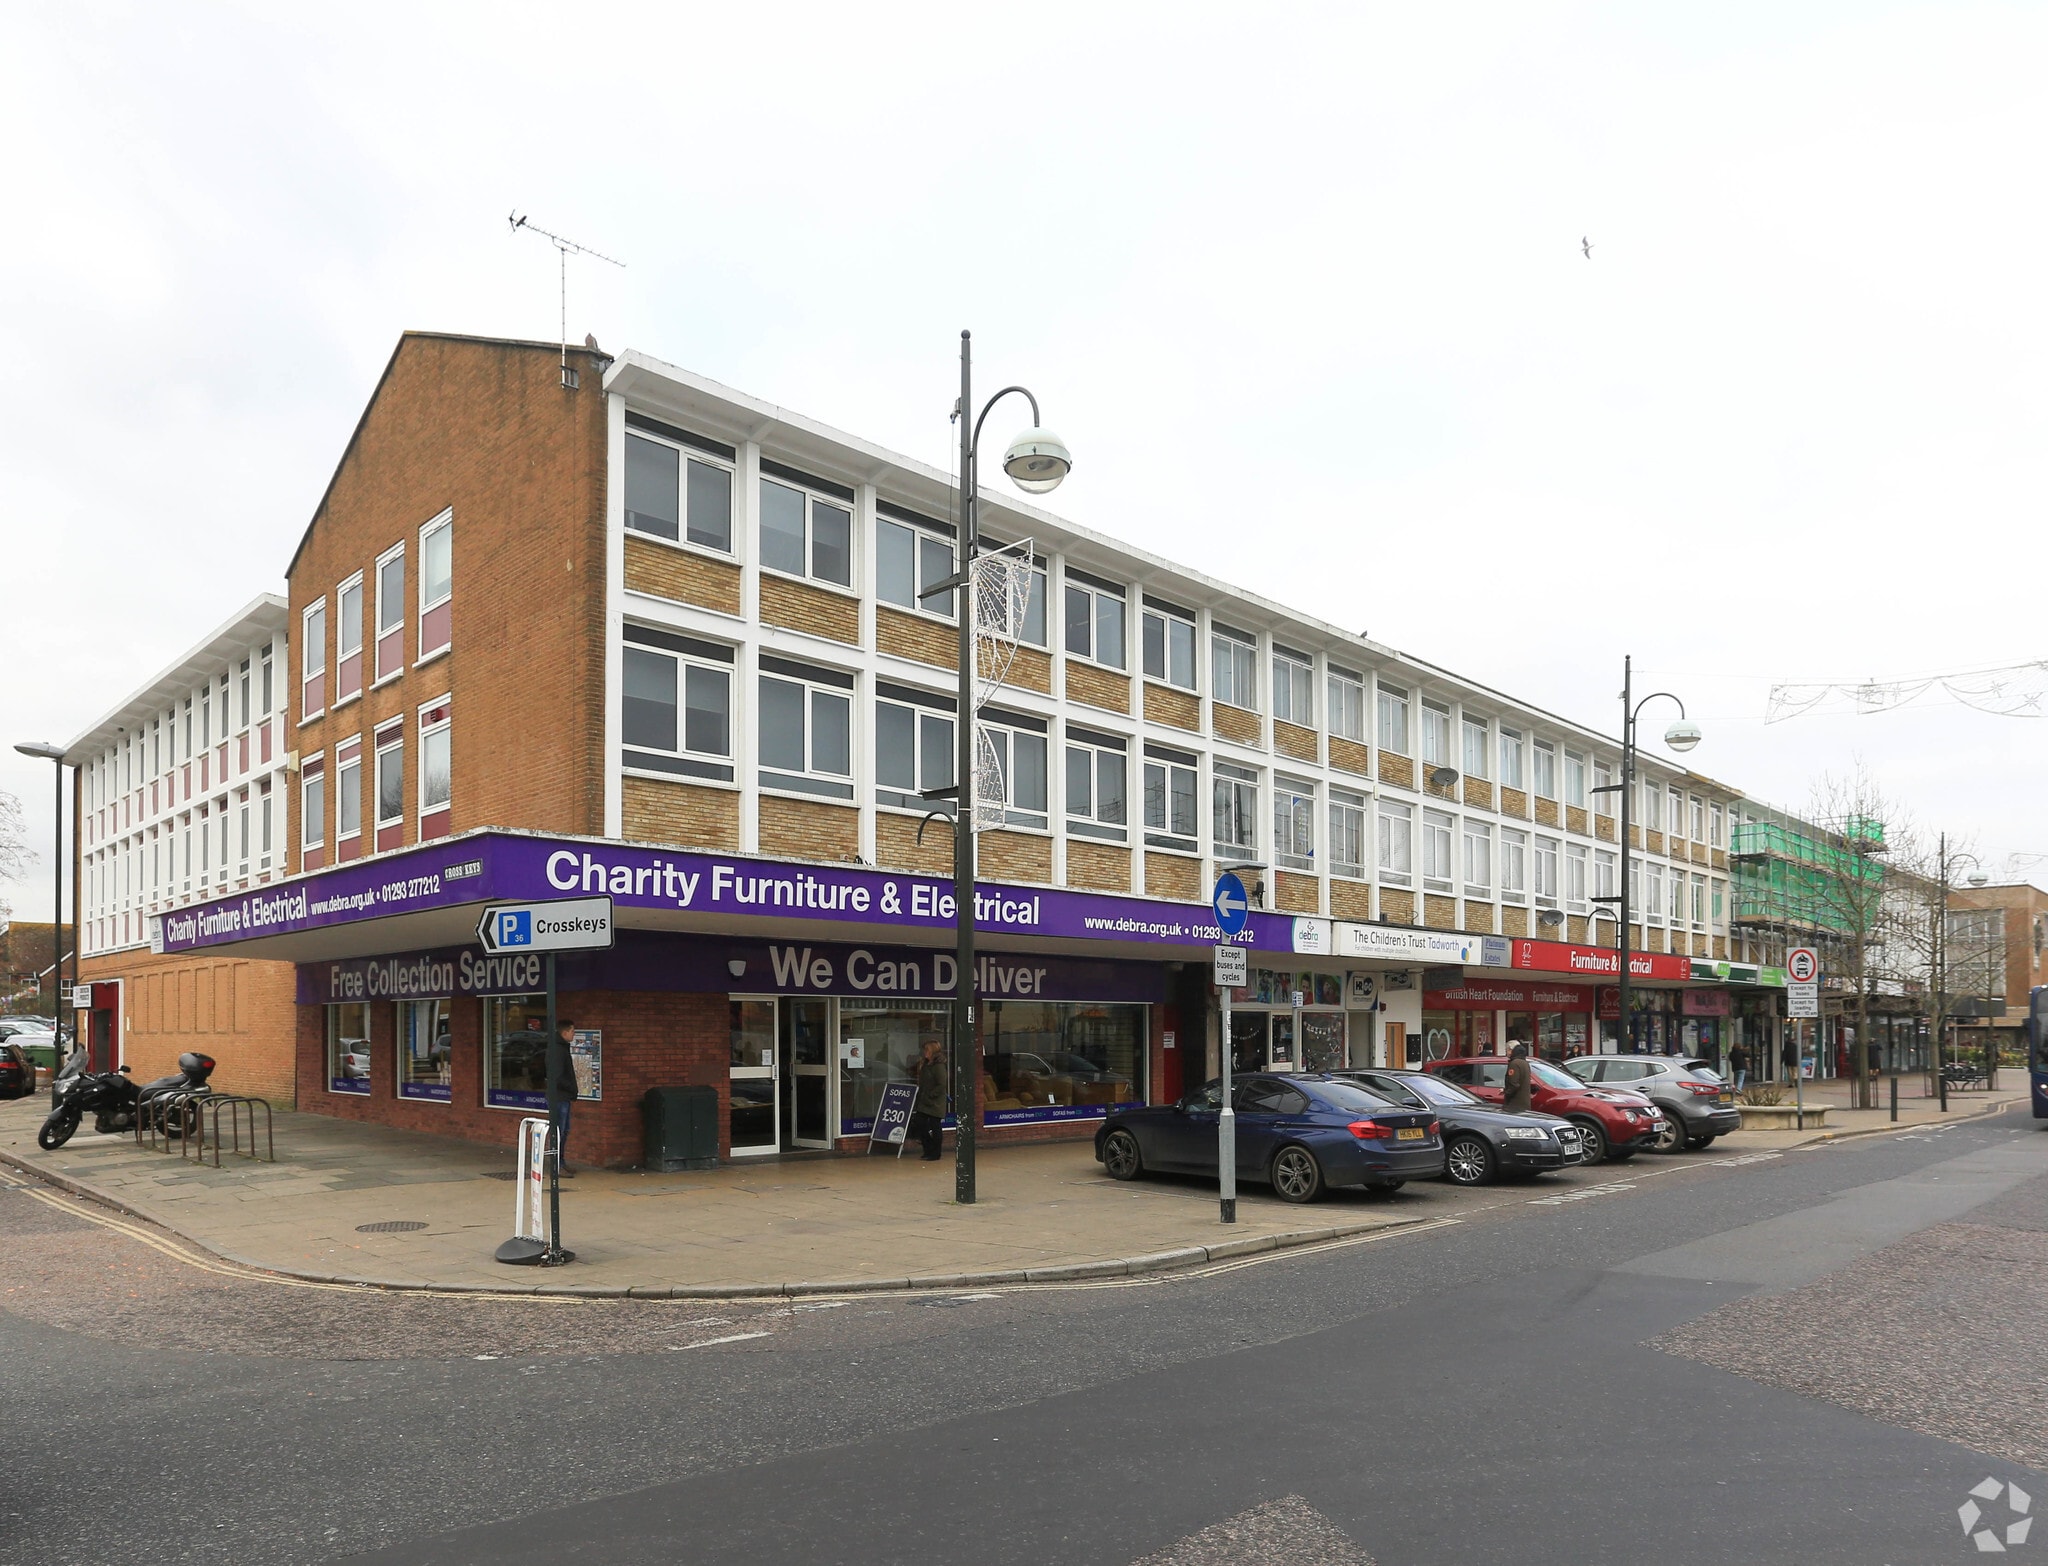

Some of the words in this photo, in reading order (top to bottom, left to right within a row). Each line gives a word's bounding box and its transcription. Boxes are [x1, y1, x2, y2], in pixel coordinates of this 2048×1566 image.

[444, 866, 463, 879] CROSS
[464, 861, 482, 876] KEYS
[545, 850, 700, 907] Charity
[711, 865, 870, 912] Furniture
[879, 881, 902, 914] &
[911, 884, 1040, 925] Eletrical
[167, 914, 197, 944] Charity
[198, 906, 241, 937] Furniture
[242, 900, 251, 929] &
[252, 887, 308, 927] Electrical
[310, 887, 376, 916] www.debra.org.uk
[382, 880, 408, 903] 01293
[408, 874, 440, 898] 277212
[502, 915, 518, 943] P
[536, 917, 606, 933] Crosskeys
[1084, 916, 1182, 938] www.debra.org.uk
[1192, 925, 1221, 940] 01293
[514, 934, 524, 943] 36
[1299, 929, 1319, 941] debra
[1353, 929, 1369, 943] The
[1370, 931, 1406, 948] Children's
[1408, 935, 1426, 949] Trust
[1428, 937, 1460, 951] Tadworth
[1221, 949, 1240, 960] Except
[1570, 951, 1610, 971] Furniture
[1611, 955, 1618, 971] &
[1618, 957, 1652, 974] ctrical
[769, 946, 832, 988] We
[846, 950, 920, 991] Can
[933, 954, 1046, 994] Dliver
[1216, 960, 1233, 969] buses
[1234, 962, 1245, 970] and
[330, 965, 363, 998] Free
[367, 956, 454, 996] Collection
[459, 951, 540, 990] Service
[1222, 973, 1240, 982] cycles
[1469, 988, 1487, 1000] Heart
[1488, 989, 1524, 1001] Foundation
[1532, 990, 1553, 1002] Furniture
[1558, 992, 1579, 1003] Electrical
[889, 1088, 911, 1098] SOFAS
[882, 1108, 905, 1123] £30
